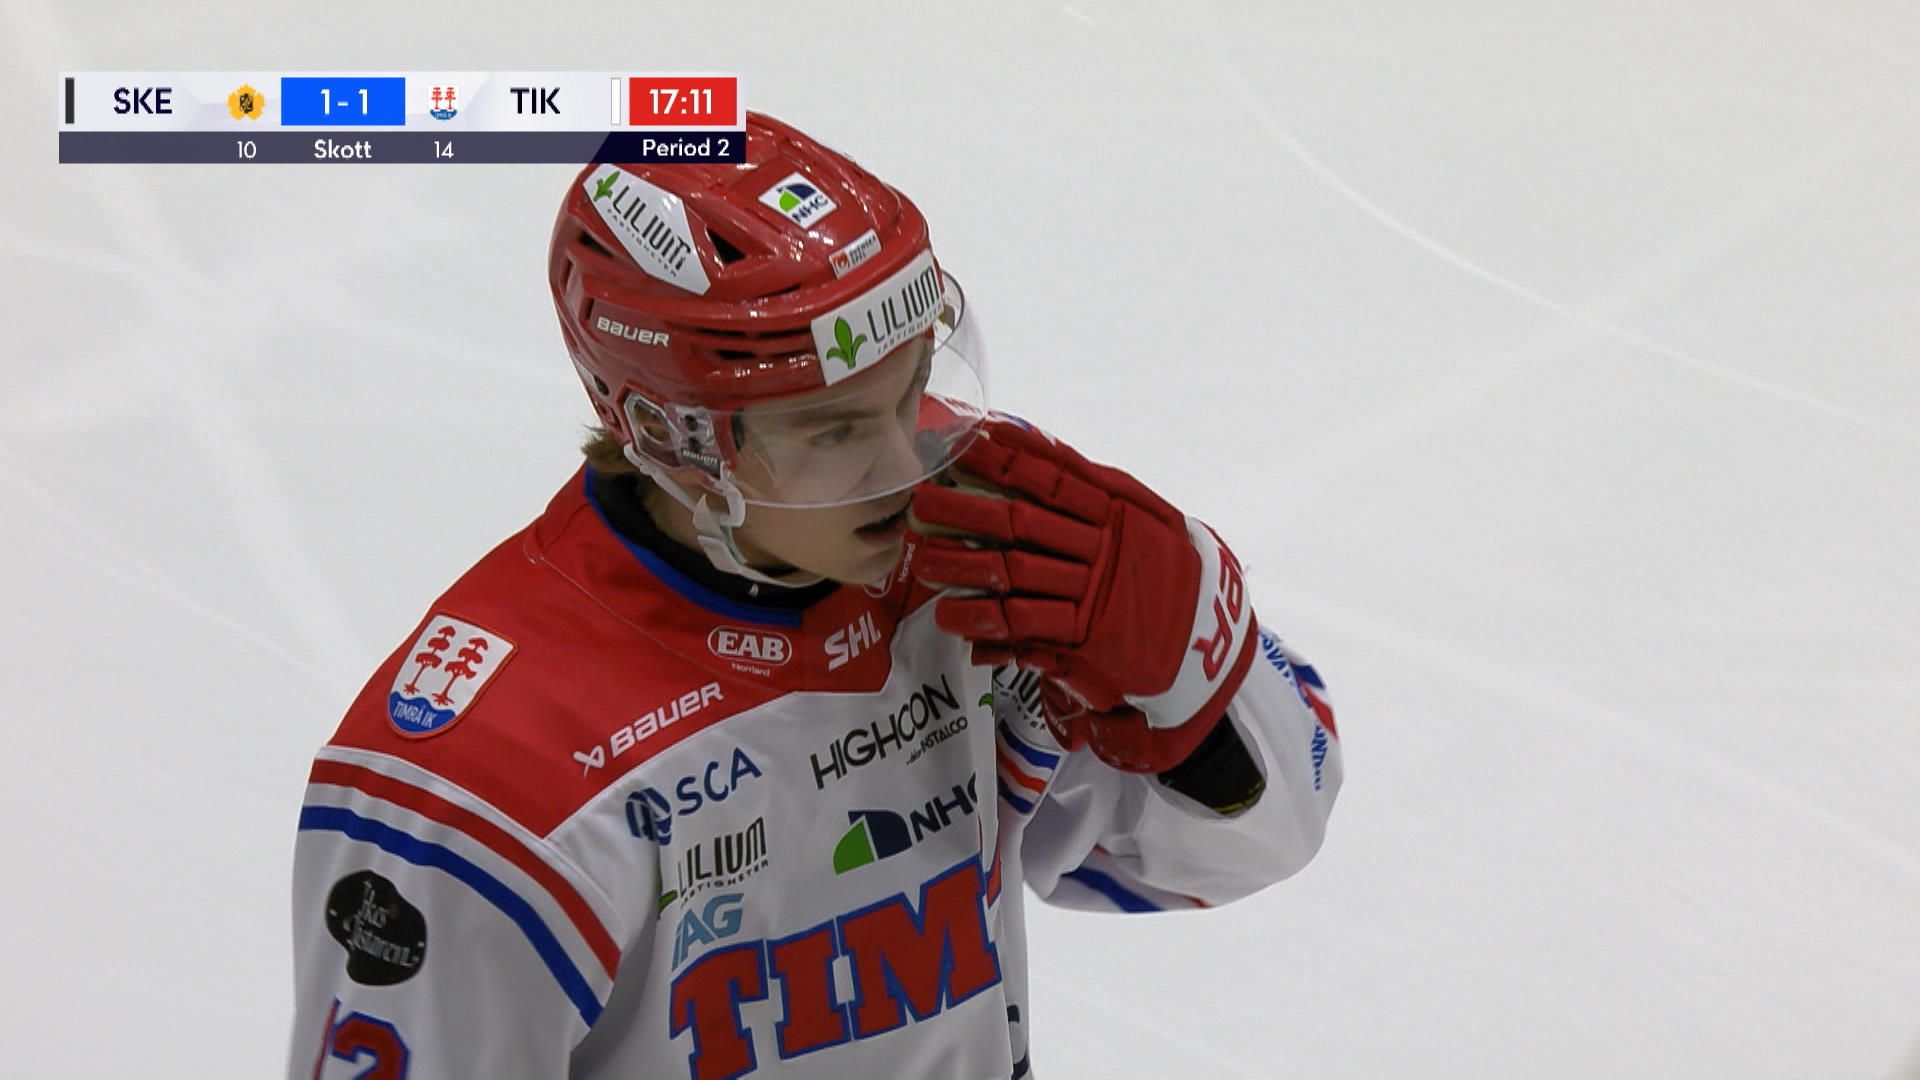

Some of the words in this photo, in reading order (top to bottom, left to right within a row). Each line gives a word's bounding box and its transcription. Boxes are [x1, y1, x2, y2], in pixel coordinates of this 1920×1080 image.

[612, 184, 691, 271] LILIUM
[791, 195, 828, 222] NHC
[597, 316, 670, 348] BAUER
[866, 265, 940, 344] LILIUM
[717, 630, 785, 662] EAB
[824, 610, 882, 671] SHL
[610, 681, 724, 758] BAUER
[809, 673, 961, 790] HIGHCON
[676, 746, 762, 817] SCA
[677, 816, 767, 898] LILIUM
